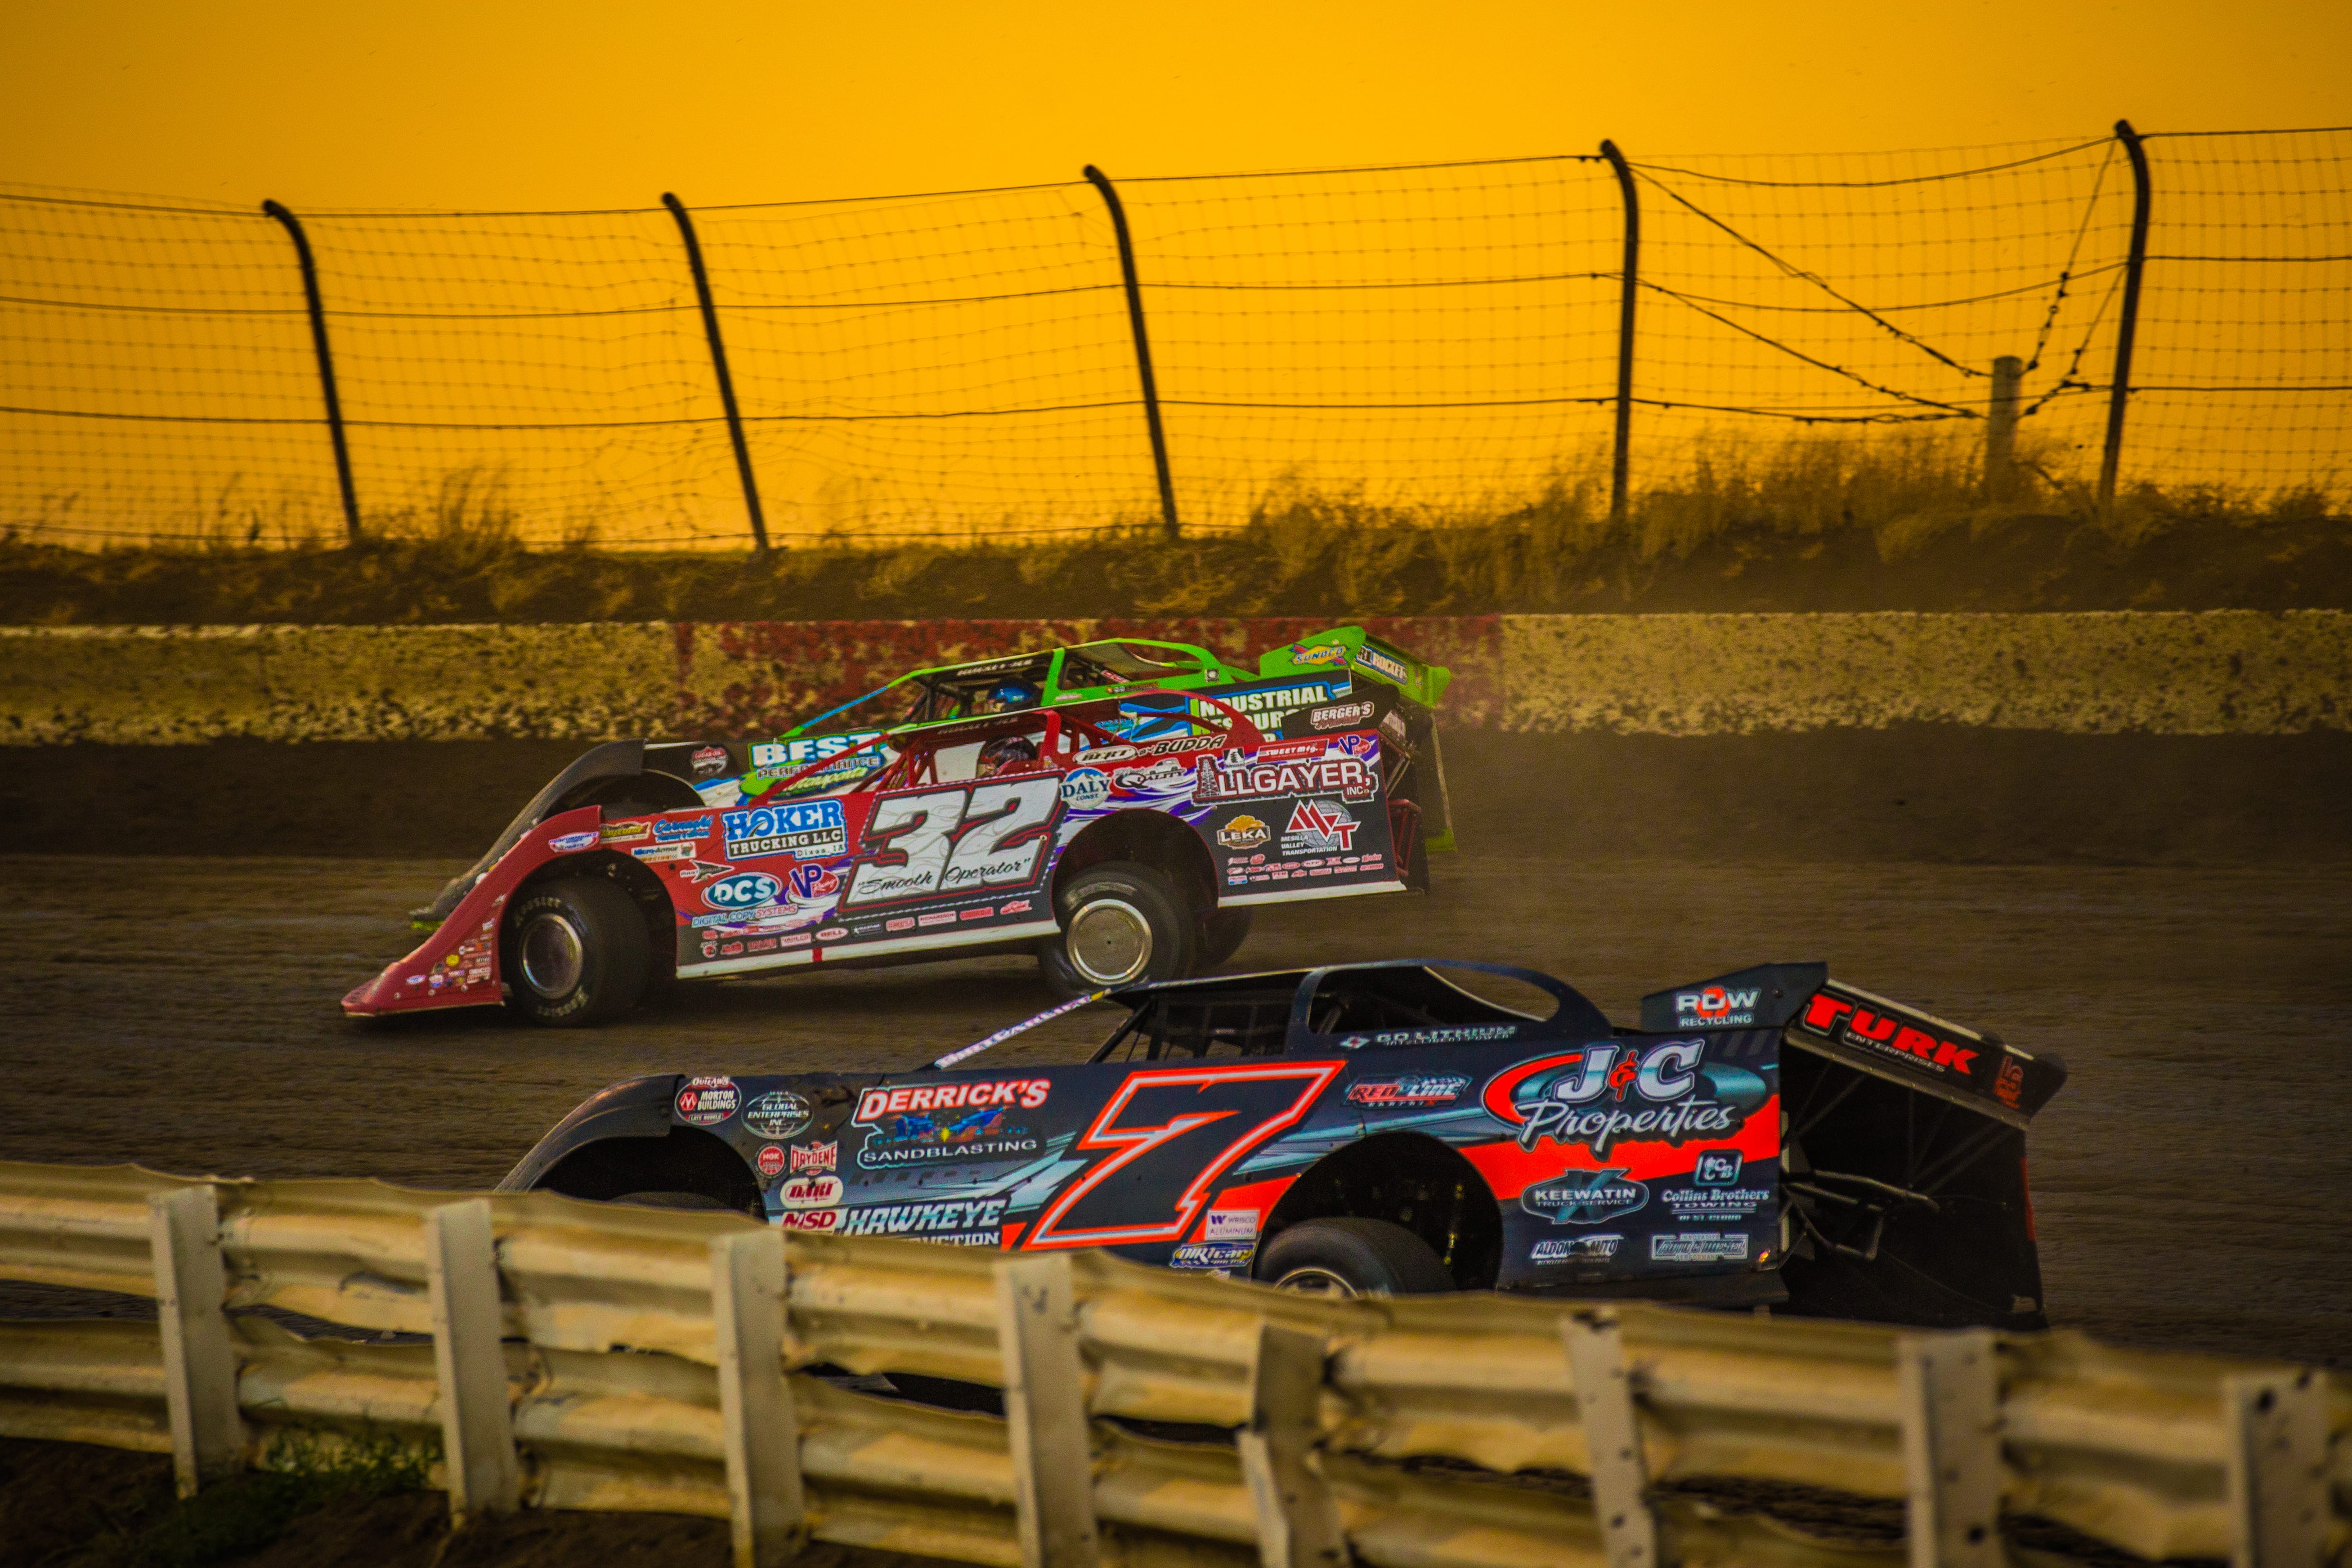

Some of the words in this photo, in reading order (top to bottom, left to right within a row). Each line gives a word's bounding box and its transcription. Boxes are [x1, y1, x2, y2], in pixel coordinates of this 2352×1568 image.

[1297, 646, 1345, 663] SUNOCO
[1313, 702, 1372, 720] BERGER'S
[752, 733, 881, 767] BEST
[1153, 736, 1227, 754] BUDDA
[1339, 735, 1360, 756] VP
[1062, 779, 1111, 798] DALY
[724, 802, 842, 841] HOKER
[730, 835, 809, 855] TRUCKING
[812, 829, 842, 844] LLC
[846, 777, 1061, 904] 32
[1221, 829, 1267, 842] LEKA
[1282, 846, 1338, 856] TRANSPORTATION
[714, 878, 773, 902] DCS
[788, 863, 823, 898] VP
[692, 913, 727, 927] DIGITAL
[729, 909, 755, 923] COPY
[756, 905, 797, 918] SYSTEMS
[1677, 989, 1761, 1012] ROW
[1680, 1013, 1753, 1027] RECYCLING
[1805, 994, 1980, 1075] TURK
[1846, 1031, 1945, 1073] ENTERPRISES
[1553, 1038, 1705, 1102] J&C
[700, 1090, 734, 1101] MORTON
[857, 1079, 1051, 1121] DERRICK'S
[1349, 1084, 1400, 1102] RED
[697, 1100, 736, 1111] BUILDINGS
[748, 1111, 809, 1119] ENTERPRISES
[1517, 1094, 1736, 1153] Properties
[791, 1145, 836, 1171] DRYDENE
[863, 1139, 1037, 1162] SANDBLASTING
[1020, 1060, 1348, 1252] 7
[1535, 1187, 1636, 1201] KEEWATIN
[1581, 1198, 1634, 1206] SERVICE
[1662, 1189, 1708, 1202] Collins
[1710, 1188, 1770, 1201] Brothers
[784, 1211, 837, 1230] MSD
[844, 1200, 1008, 1236] HAWKEYE
[1534, 1240, 1573, 1256] ALDON
